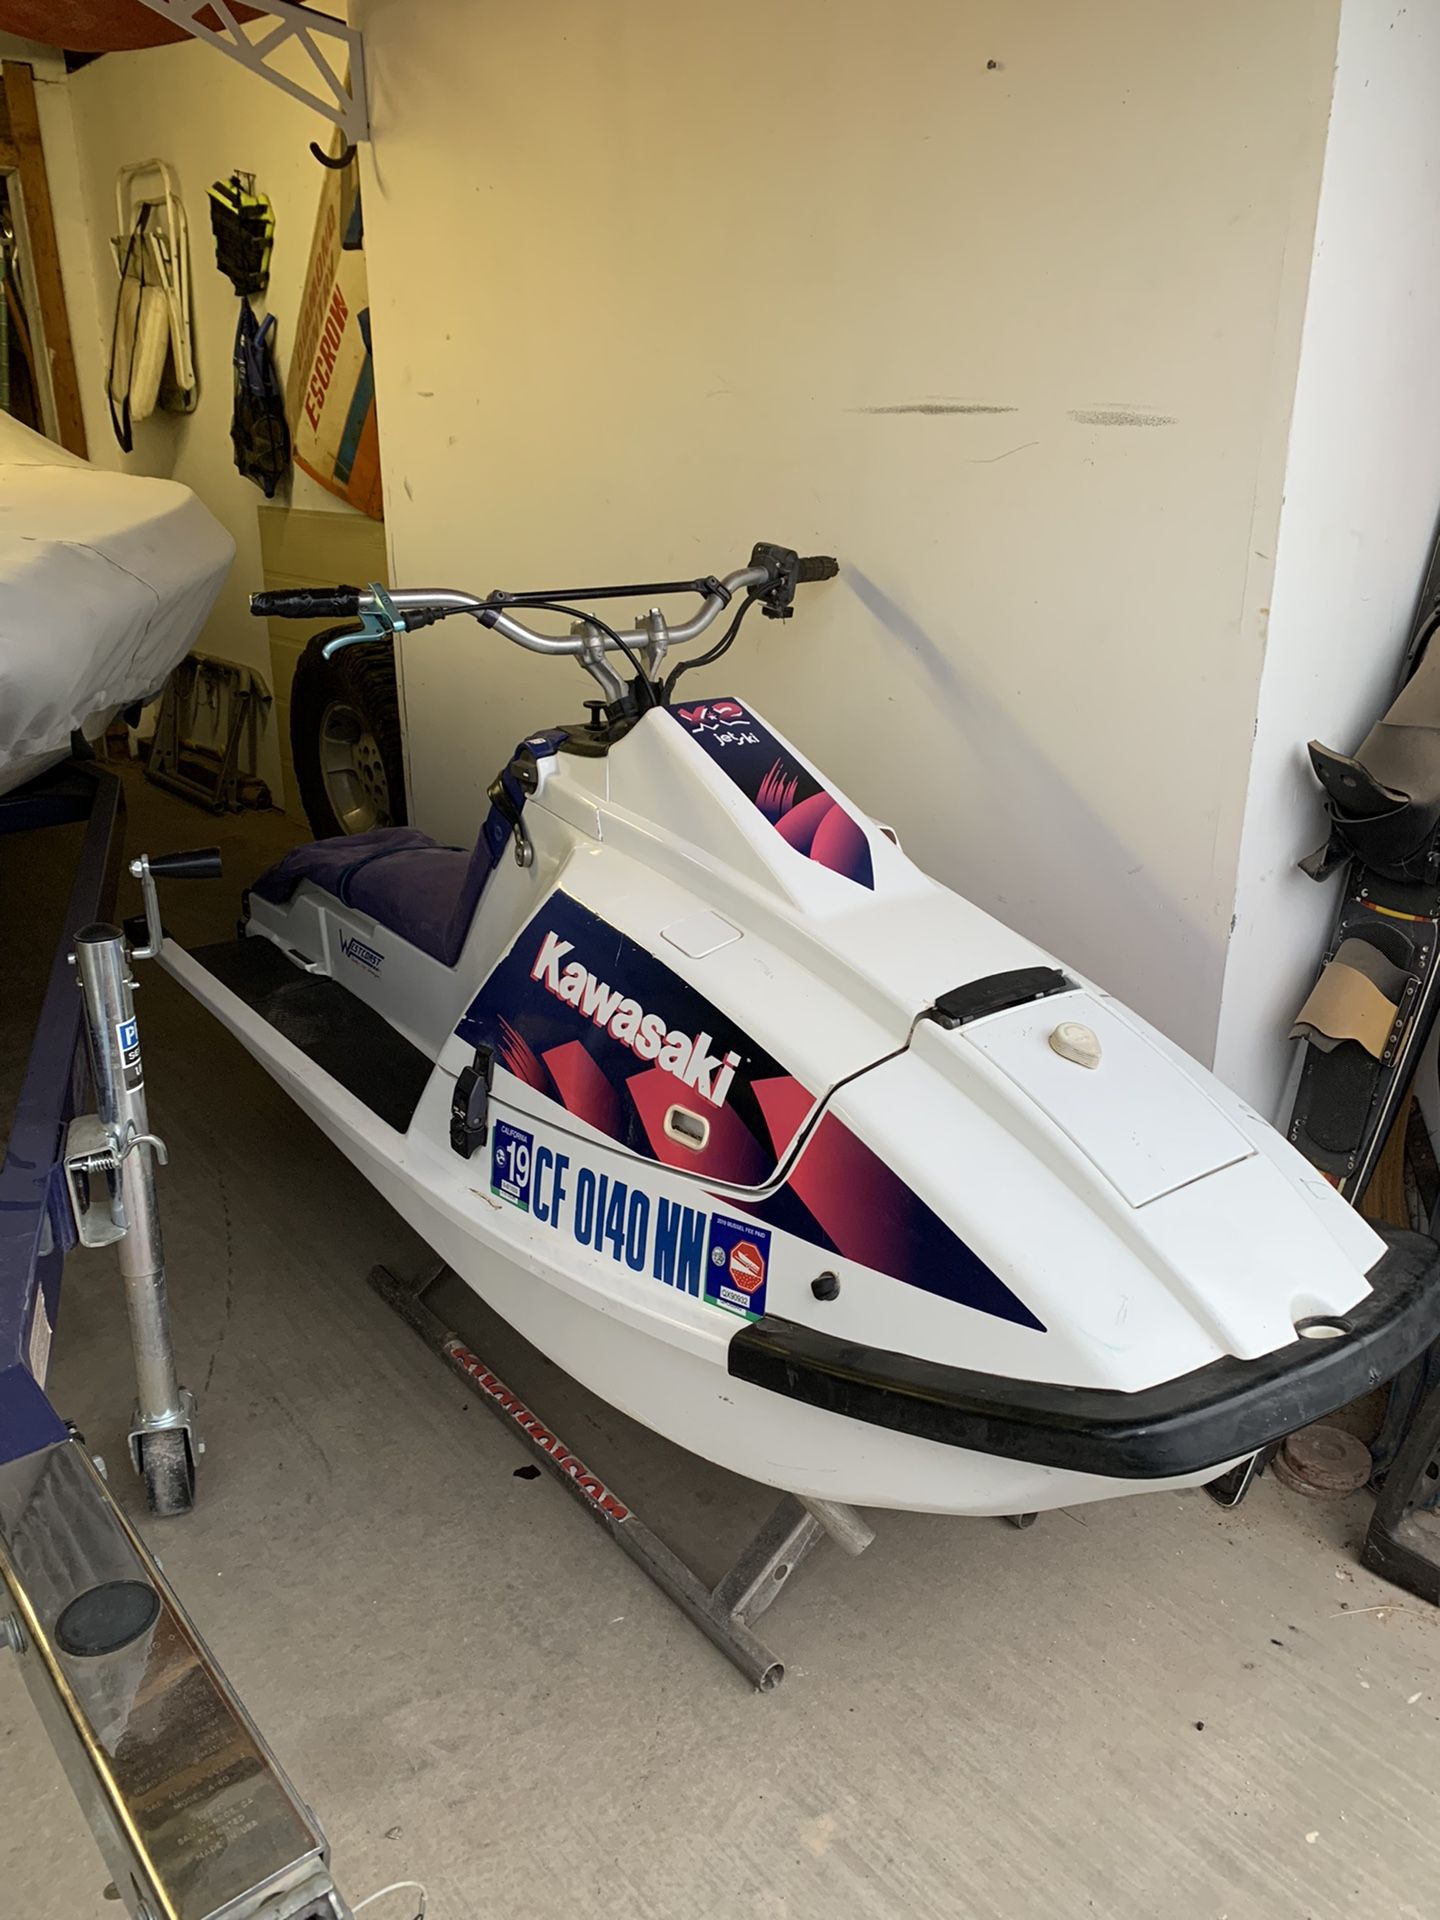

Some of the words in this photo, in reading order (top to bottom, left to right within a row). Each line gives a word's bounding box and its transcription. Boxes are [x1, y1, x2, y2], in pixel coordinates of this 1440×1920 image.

[304, 284, 349, 432] ESCROW
[530, 930, 742, 1109] Kawasaki
[501, 1125, 528, 1144] CALIFORNIA
[507, 1141, 530, 1188] 19
[532, 1146, 570, 1228] CF
[574, 1167, 650, 1272] 0140
[653, 1197, 707, 1298] NN
